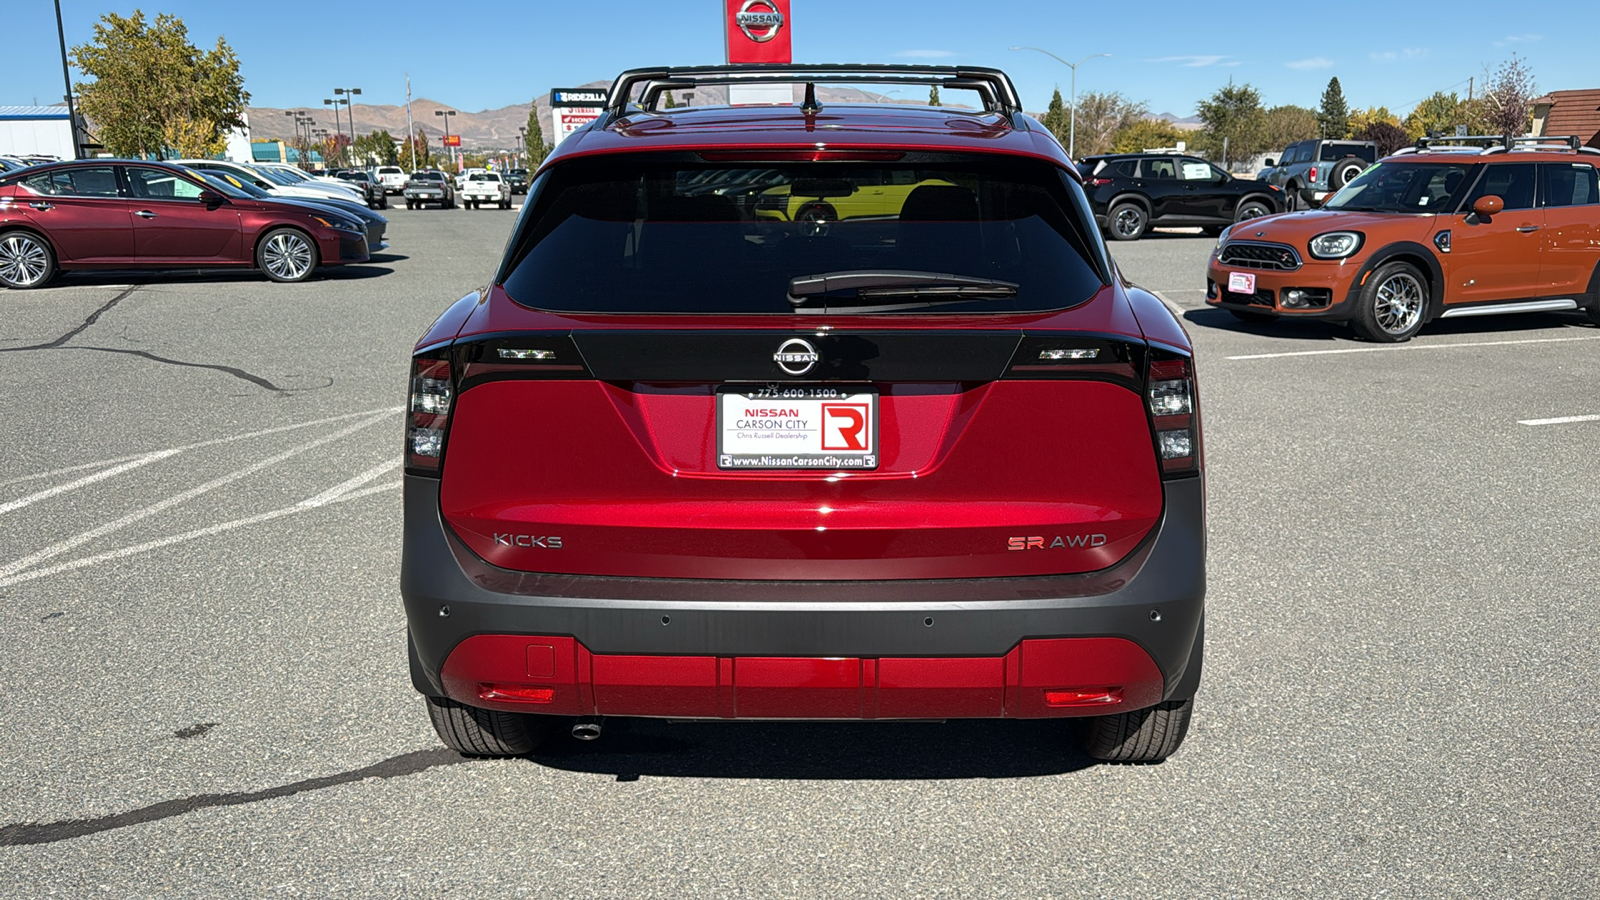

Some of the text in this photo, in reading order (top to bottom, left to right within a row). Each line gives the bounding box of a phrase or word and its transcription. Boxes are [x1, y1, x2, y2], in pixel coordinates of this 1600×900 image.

[568, 93, 606, 101] RIDEZILLA
[773, 354, 818, 362] NISSAN
[758, 389, 837, 398] 775-600-1500
[745, 409, 799, 417] NISSAN
[736, 420, 808, 429] CARSON CITY
[775, 432, 808, 440] Dealership
[733, 456, 862, 468] www.NissanCarsonCity.com
[493, 532, 563, 549] KICKS
[1007, 533, 1107, 551] SR AWD
